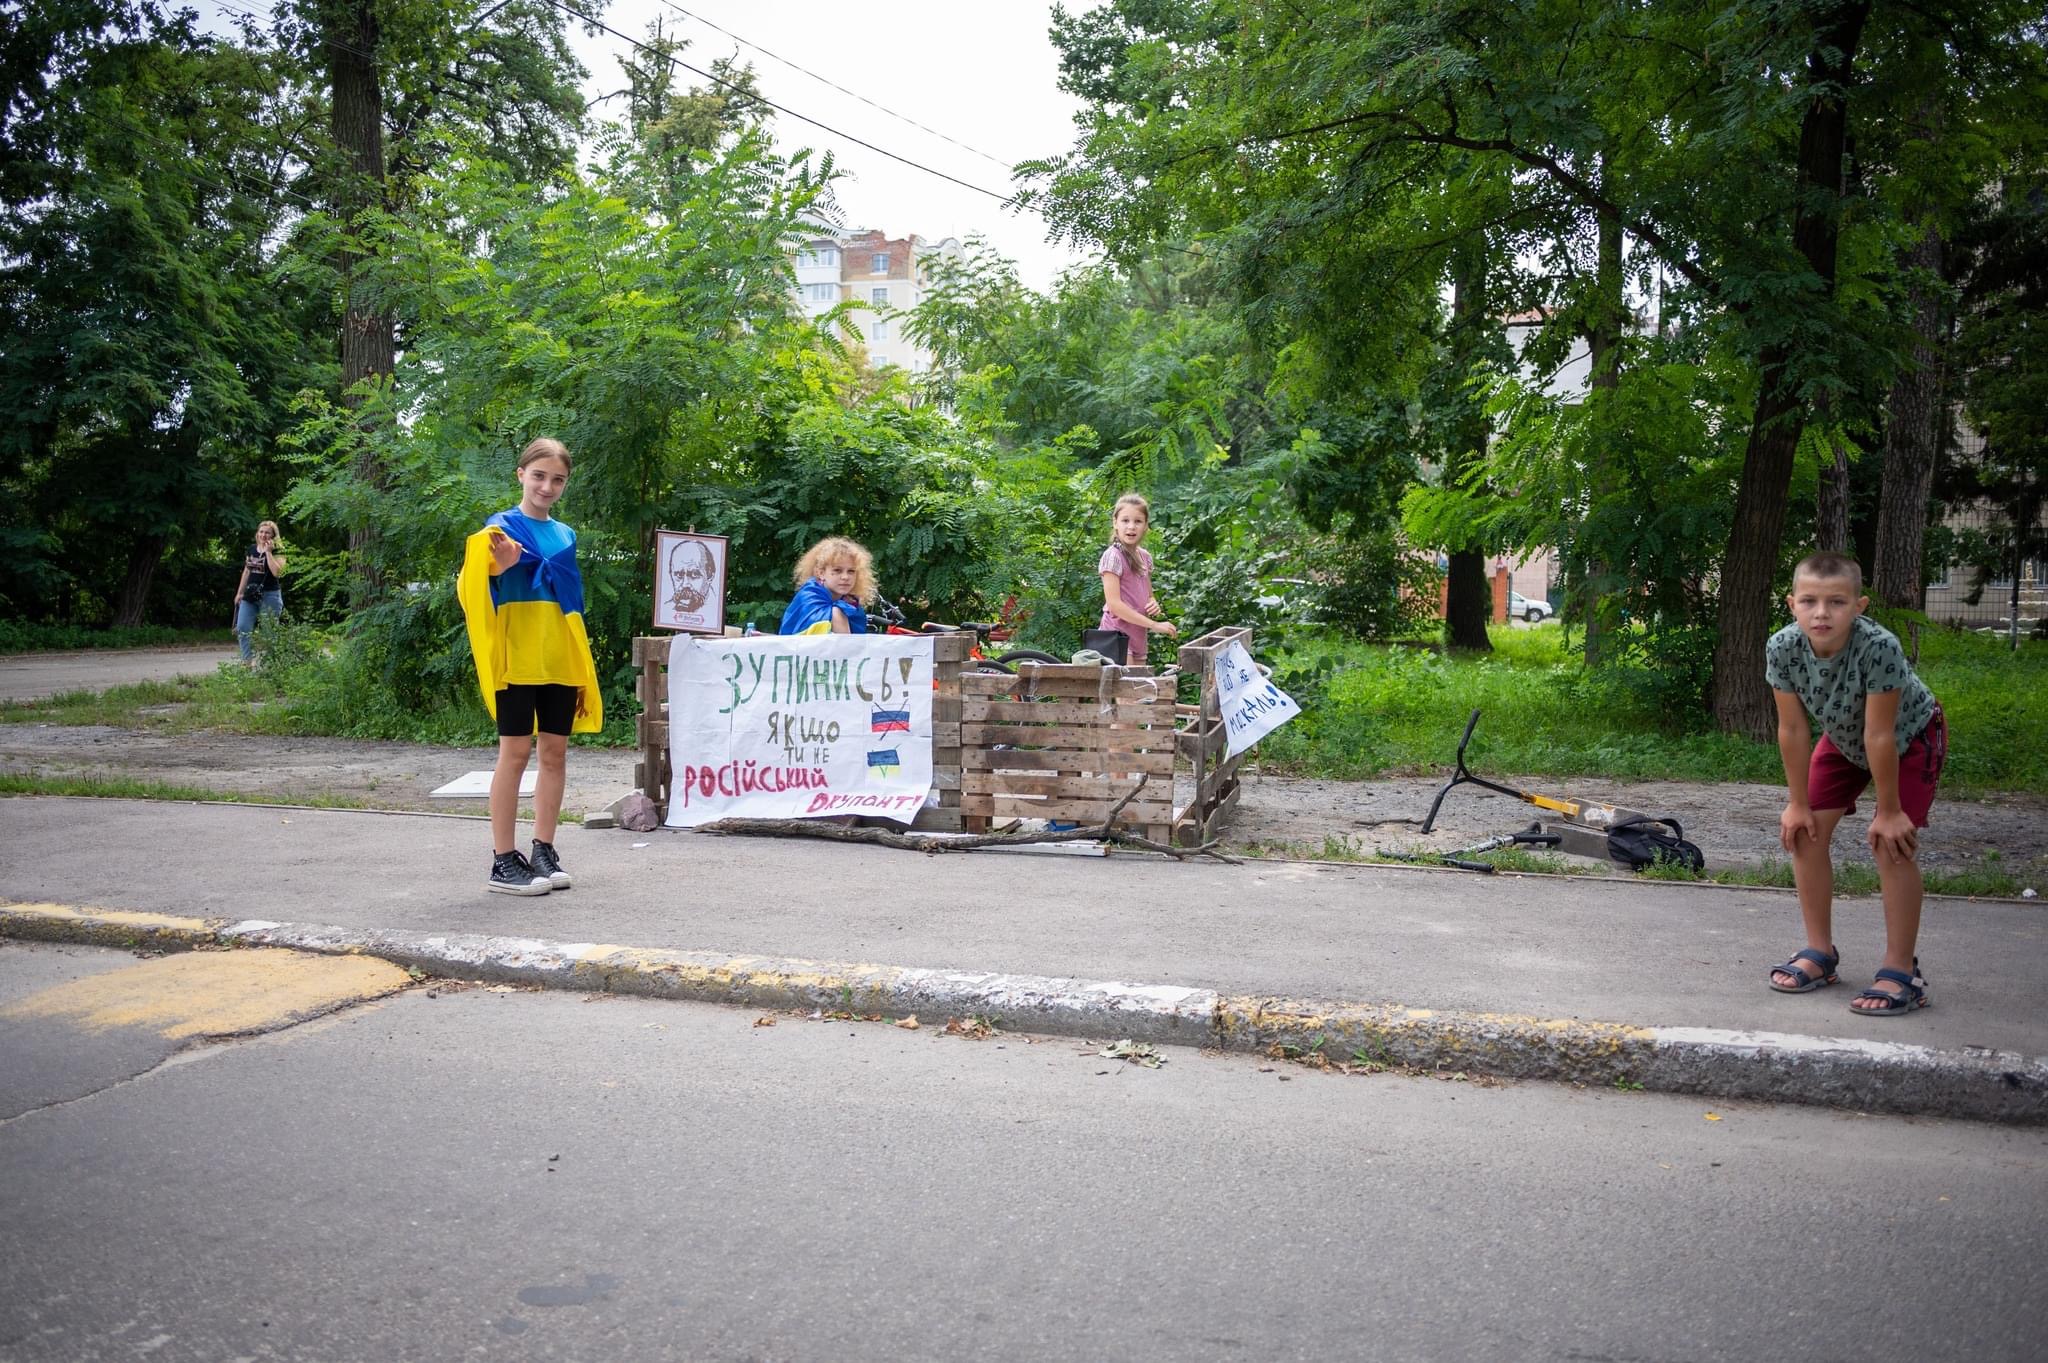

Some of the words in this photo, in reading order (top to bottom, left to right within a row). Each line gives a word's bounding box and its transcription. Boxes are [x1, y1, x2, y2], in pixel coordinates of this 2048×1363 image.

[718, 652, 914, 713] ЗУПИНИСЬ!
[767, 711, 841, 748] ЯКЩО
[784, 746, 804, 765] ТИ
[813, 747, 830, 765] НЕ
[683, 759, 829, 808] РОСІЙСЬКИЙ
